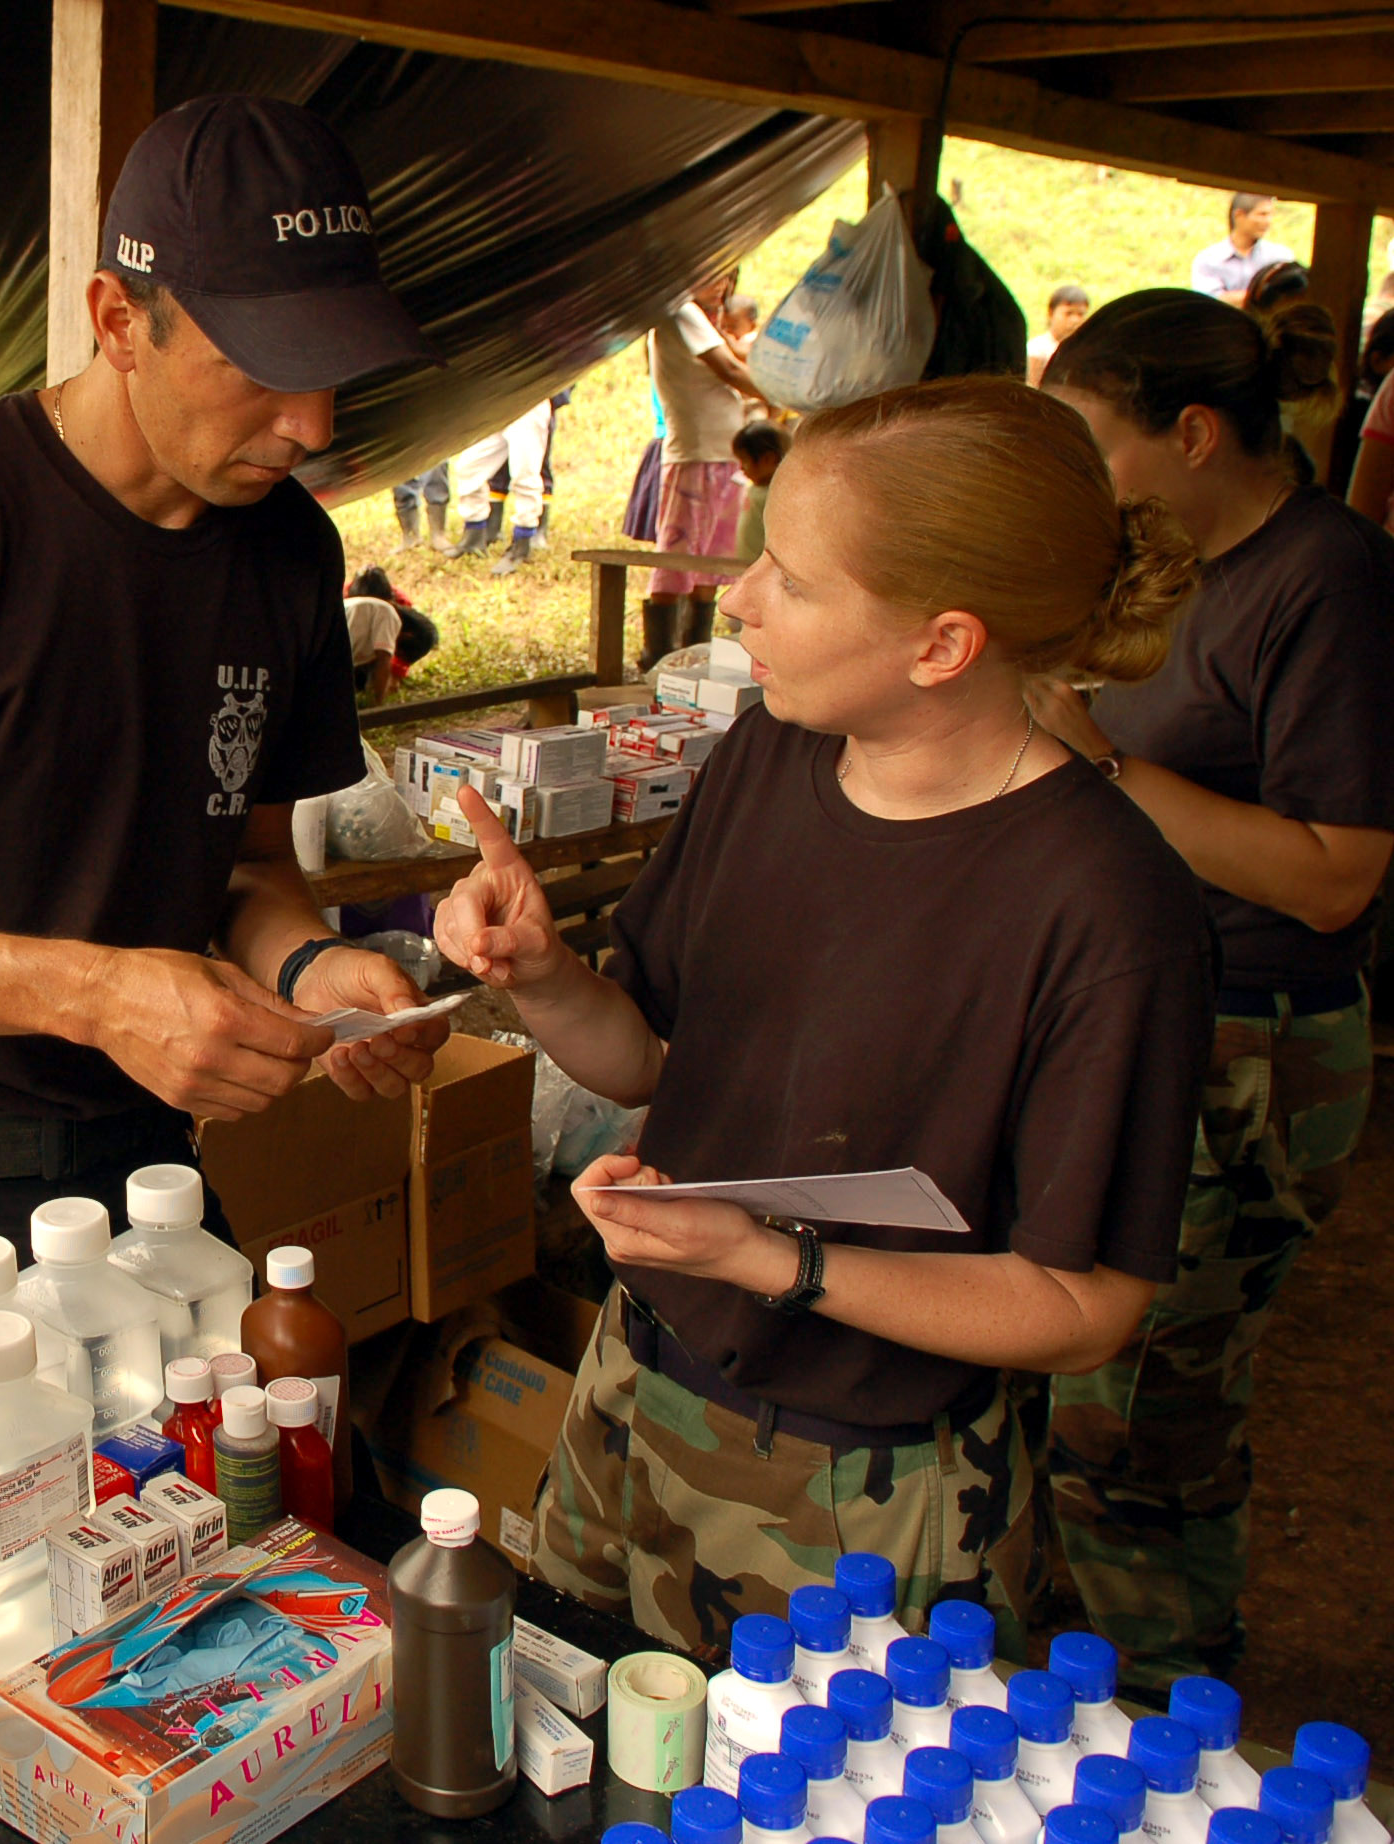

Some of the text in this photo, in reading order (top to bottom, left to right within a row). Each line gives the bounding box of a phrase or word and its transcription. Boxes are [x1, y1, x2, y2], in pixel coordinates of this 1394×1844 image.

[217, 664, 271, 691] U.I.P.
[206, 793, 248, 816] C.R.
[192, 1514, 224, 1543] Afrin
[144, 1536, 175, 1566] Afrin
[102, 1555, 132, 1587] Afrin
[164, 1607, 384, 1736] AURELIA
[210, 1681, 383, 1818] AURELI
